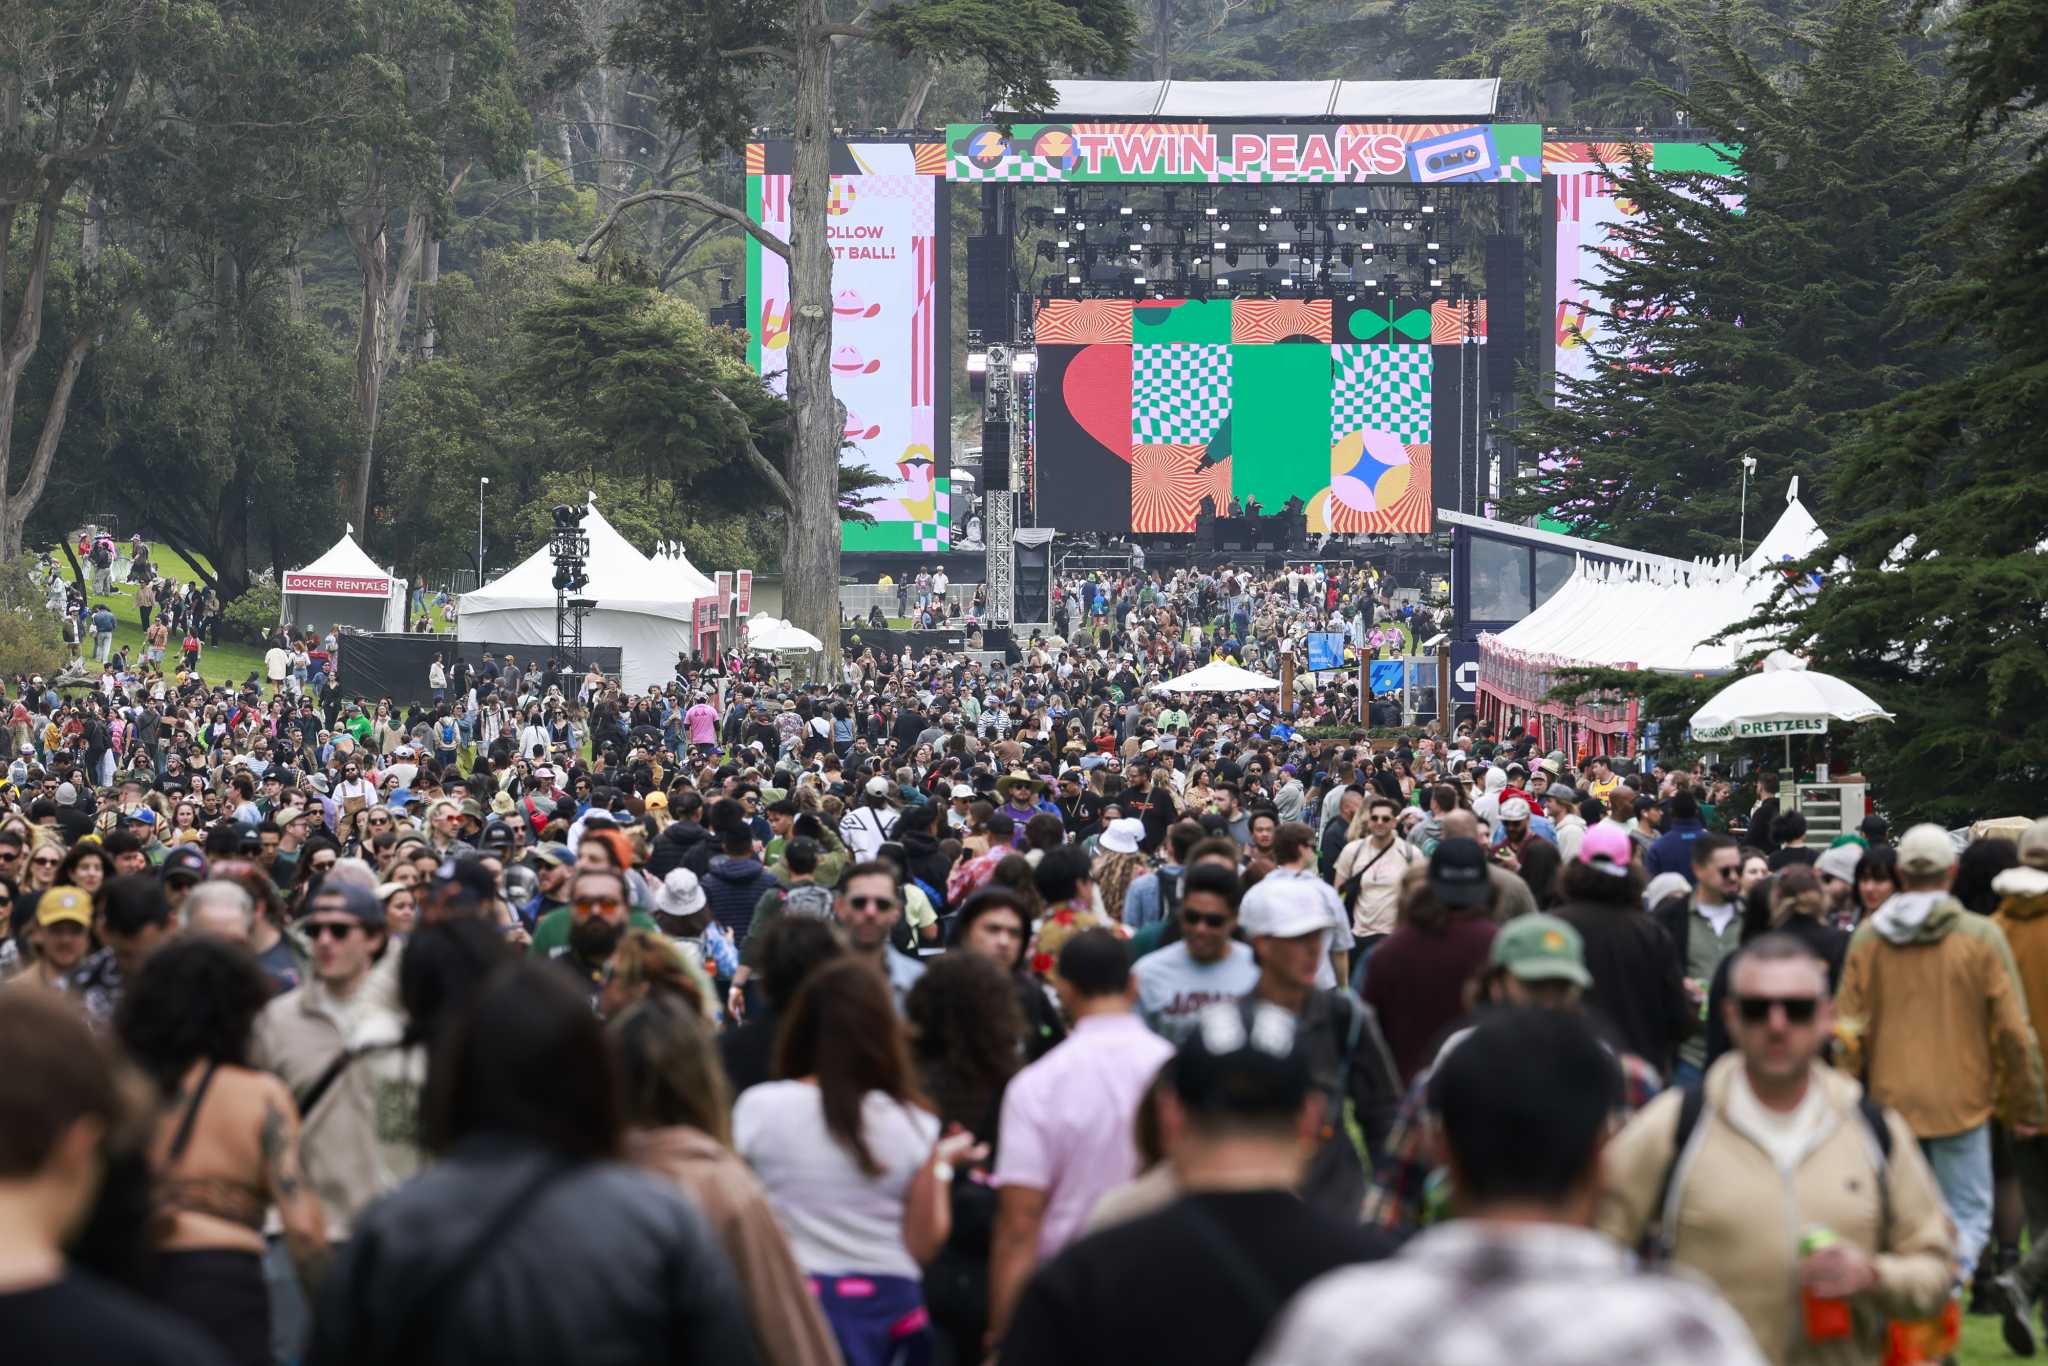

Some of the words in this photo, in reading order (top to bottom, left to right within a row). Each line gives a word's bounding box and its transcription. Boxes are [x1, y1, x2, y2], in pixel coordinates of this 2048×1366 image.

[1080, 134, 1218, 174] TWIN
[1232, 134, 1406, 175] PEAKS
[825, 226, 883, 239] OLLOW
[849, 246, 896, 259] BALL!
[287, 579, 332, 588] LOCKER
[336, 581, 388, 591] RENTALS
[1741, 719, 1822, 735] PRETZELS
